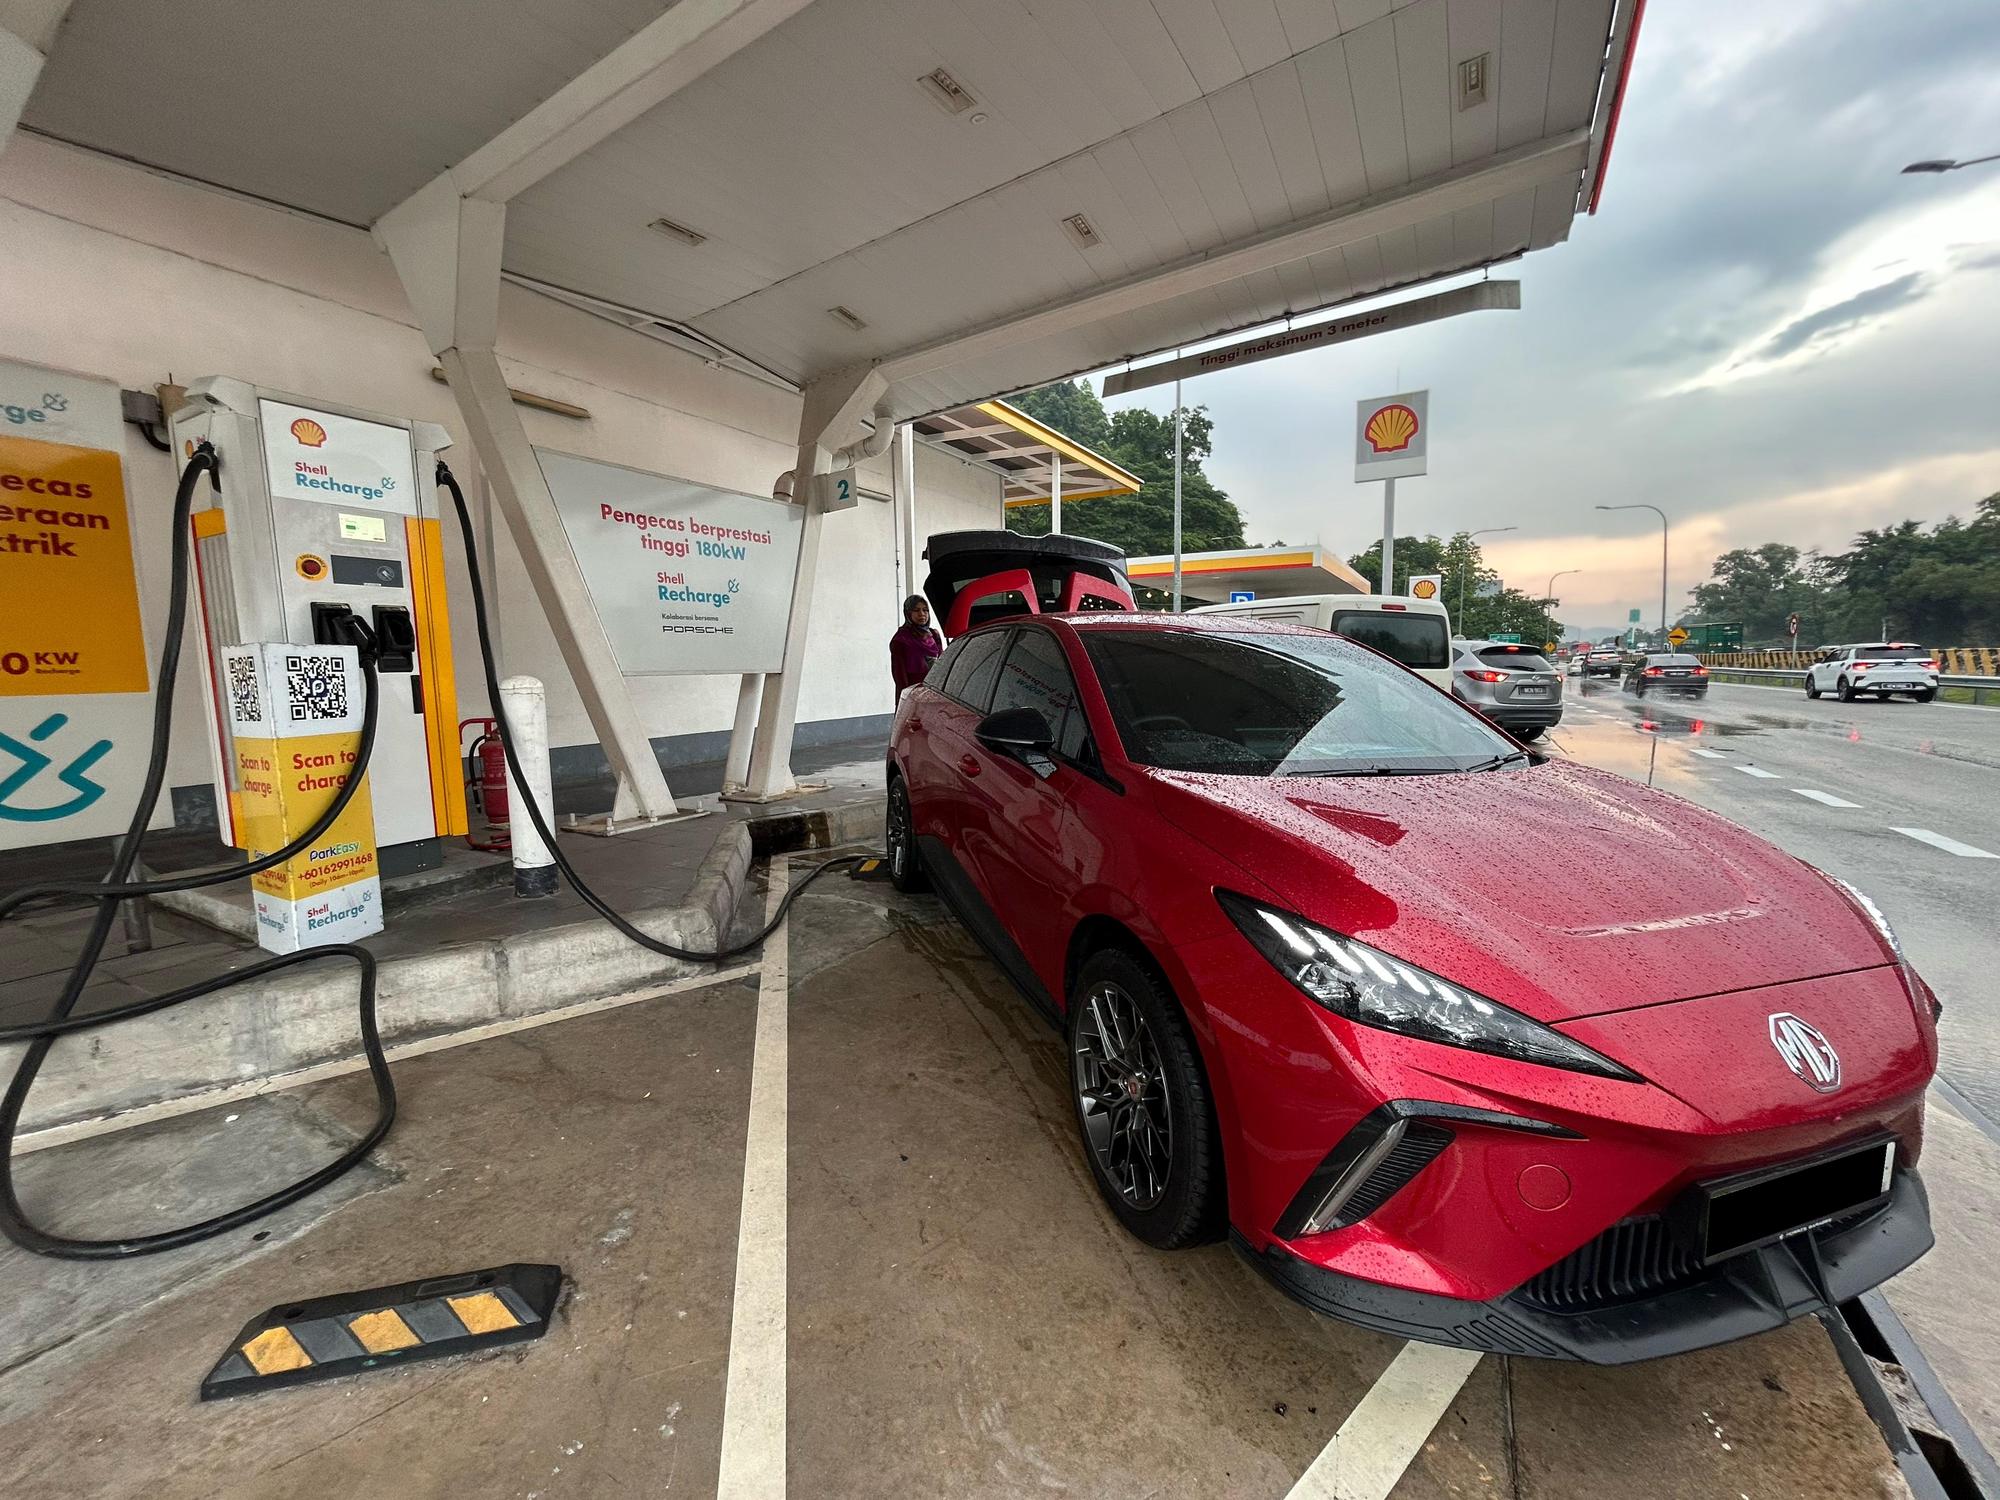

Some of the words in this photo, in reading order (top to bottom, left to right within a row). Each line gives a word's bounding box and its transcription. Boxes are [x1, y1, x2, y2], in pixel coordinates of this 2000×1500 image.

[1200, 348, 1240, 367] Tinggi
[1244, 330, 1323, 356] maksimum
[1327, 325, 1337, 336] 3
[1341, 314, 1388, 333] meter
[0, 404, 46, 424] ge
[295, 461, 328, 476] Shell
[0, 474, 93, 499] ecas
[295, 472, 384, 500] Recharge
[837, 479, 850, 500] 2
[600, 503, 685, 532] Pengecas
[689, 517, 772, 545] berprestasi
[0, 532, 78, 557] trik
[640, 533, 690, 558] tinggi
[696, 540, 746, 562] 180kW
[657, 571, 685, 585] Shell
[658, 584, 731, 608] Recharge
[662, 625, 734, 635] PORSCHE
[34, 652, 79, 666] KW
[240, 753, 259, 771] Scan
[260, 758, 270, 772] to
[293, 751, 335, 770] Scan
[340, 750, 357, 764] to
[244, 780, 272, 798] charge
[298, 774, 350, 792] charg
[309, 842, 360, 862] ParkEasy
[297, 853, 373, 881] +60162991468
[307, 904, 329, 919] Shell
[308, 904, 365, 930] Recharge
[1776, 1019, 1836, 1083] MG
